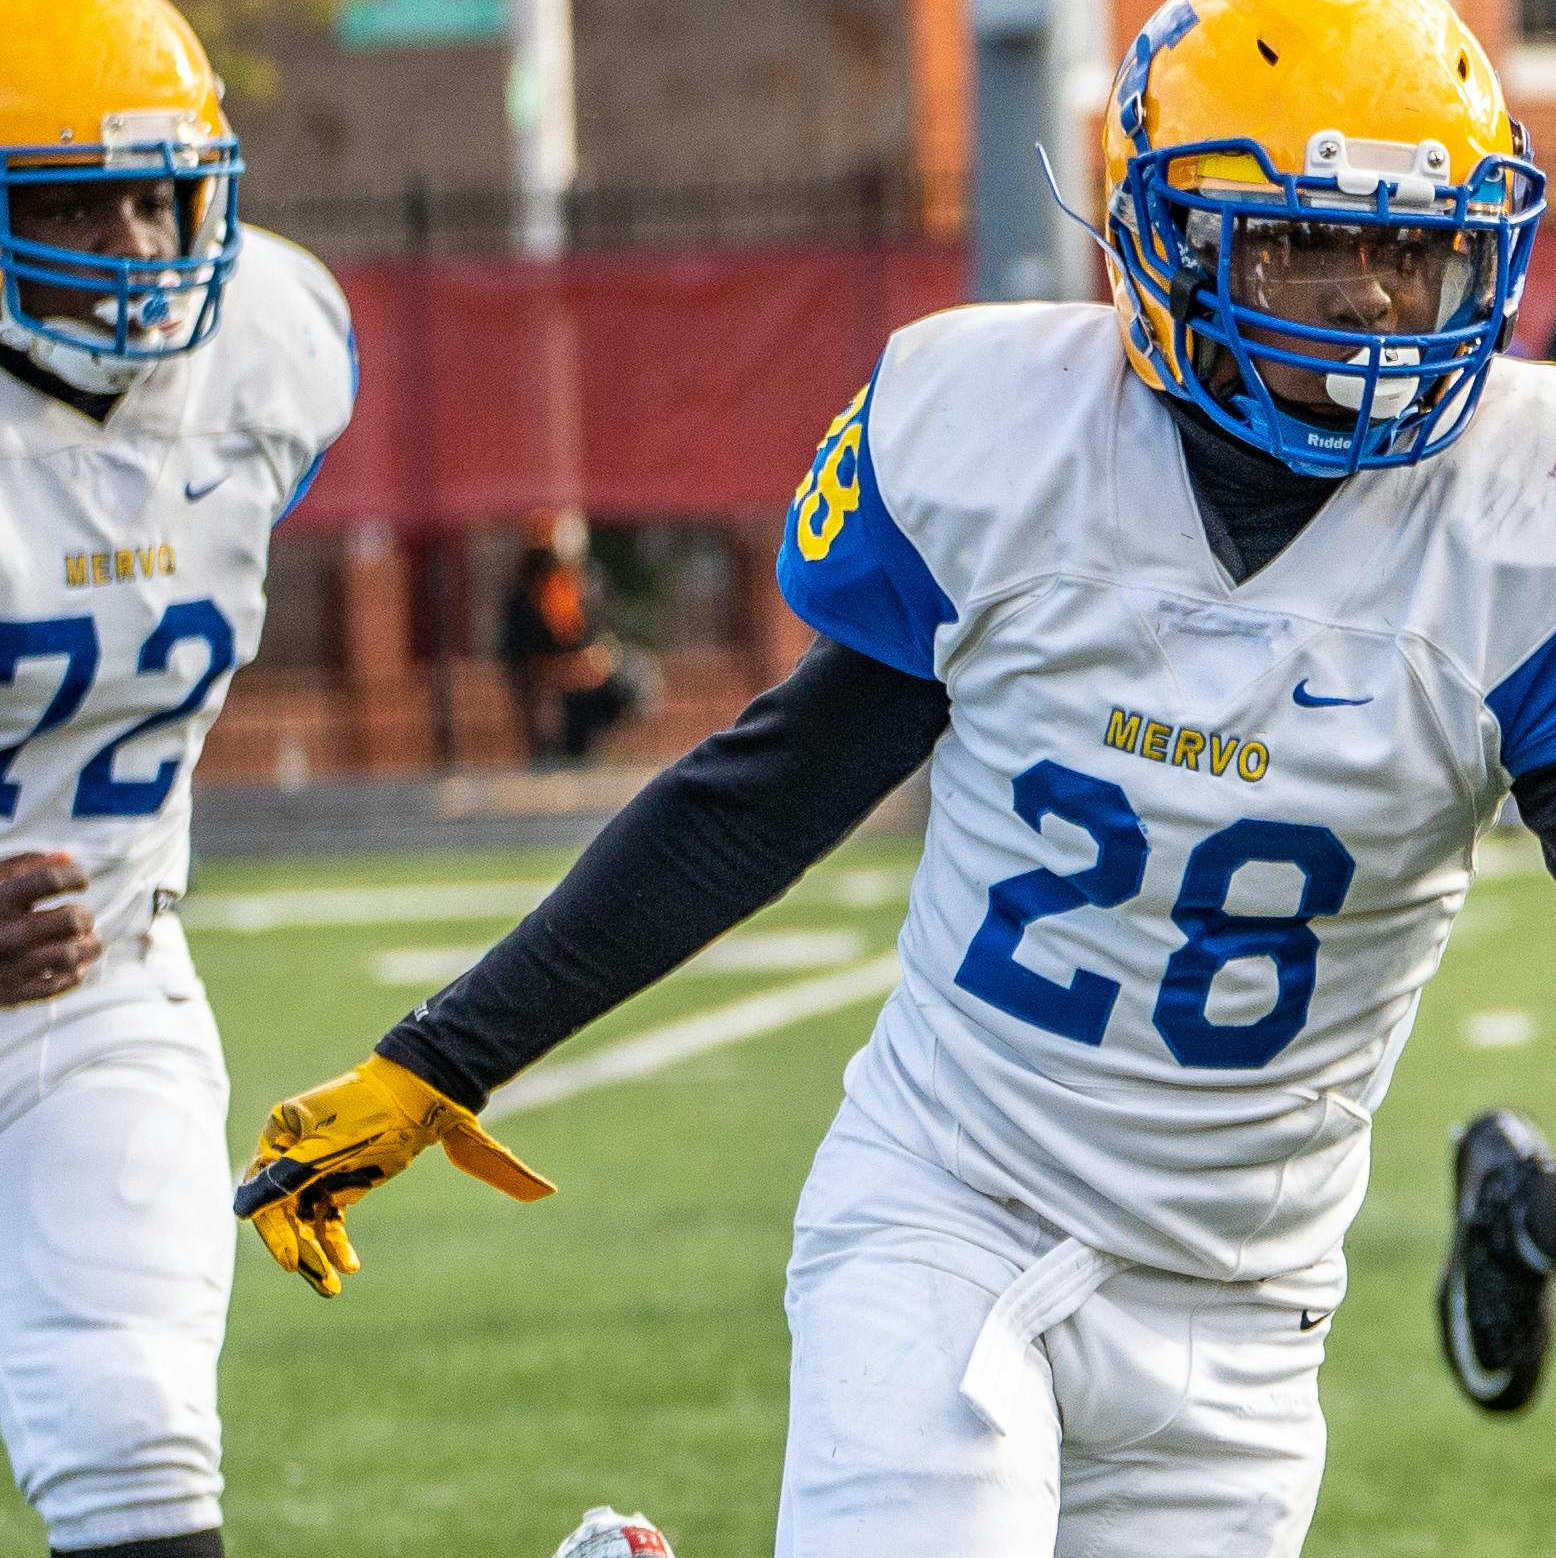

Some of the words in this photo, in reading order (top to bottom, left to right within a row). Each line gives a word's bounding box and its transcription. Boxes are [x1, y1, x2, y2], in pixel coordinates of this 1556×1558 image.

[1308, 433, 1353, 449] Ridde
[65, 542, 175, 587] MERVO
[0, 599, 236, 823] 72
[1104, 705, 1270, 784] MERVO
[954, 759, 1356, 1068] 28
